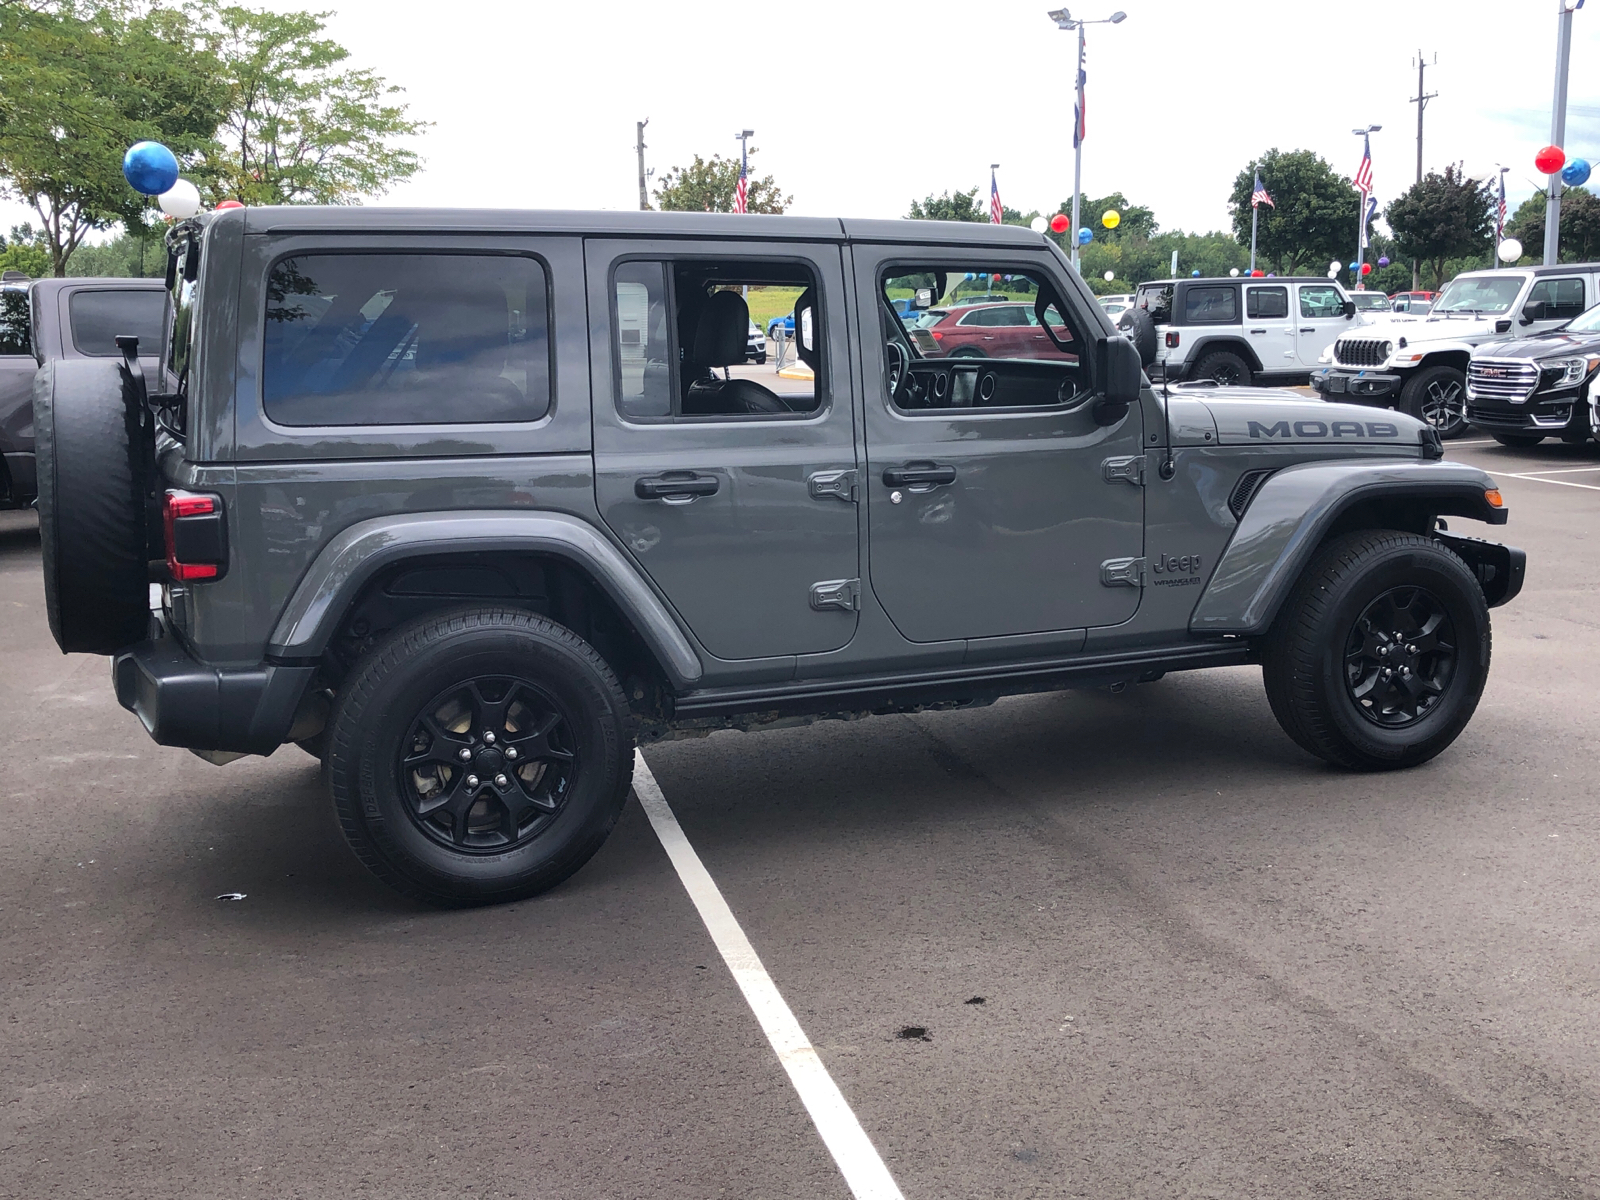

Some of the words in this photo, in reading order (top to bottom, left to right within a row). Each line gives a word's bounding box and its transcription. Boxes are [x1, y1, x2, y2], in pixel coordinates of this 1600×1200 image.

[1480, 367, 1507, 378] GMC
[1247, 420, 1399, 439] MOAB
[1153, 553, 1202, 574] Jeep
[1153, 577, 1201, 587] WRANGLER
